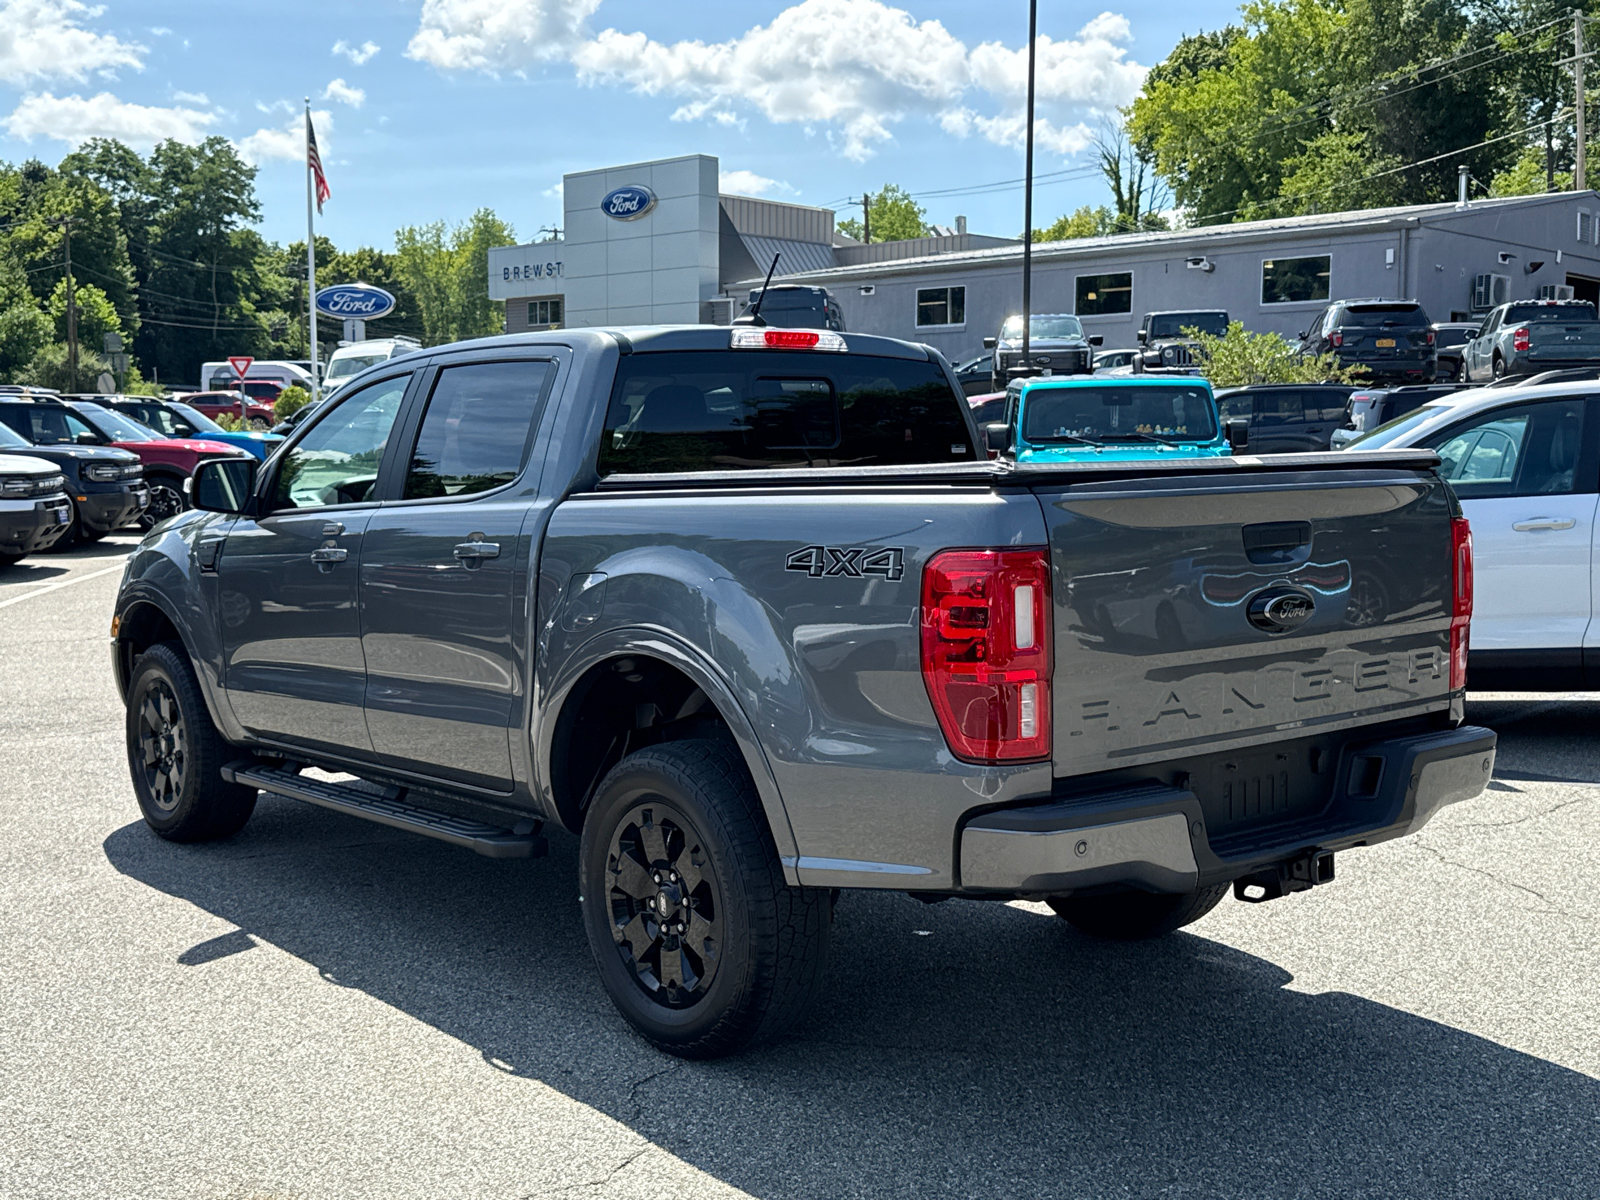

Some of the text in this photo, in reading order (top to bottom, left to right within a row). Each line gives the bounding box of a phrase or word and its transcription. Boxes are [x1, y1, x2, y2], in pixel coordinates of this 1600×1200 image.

[610, 192, 639, 213] Ford
[503, 261, 562, 281] BREWST
[329, 291, 377, 312] Ford
[1280, 600, 1307, 618] Ford
